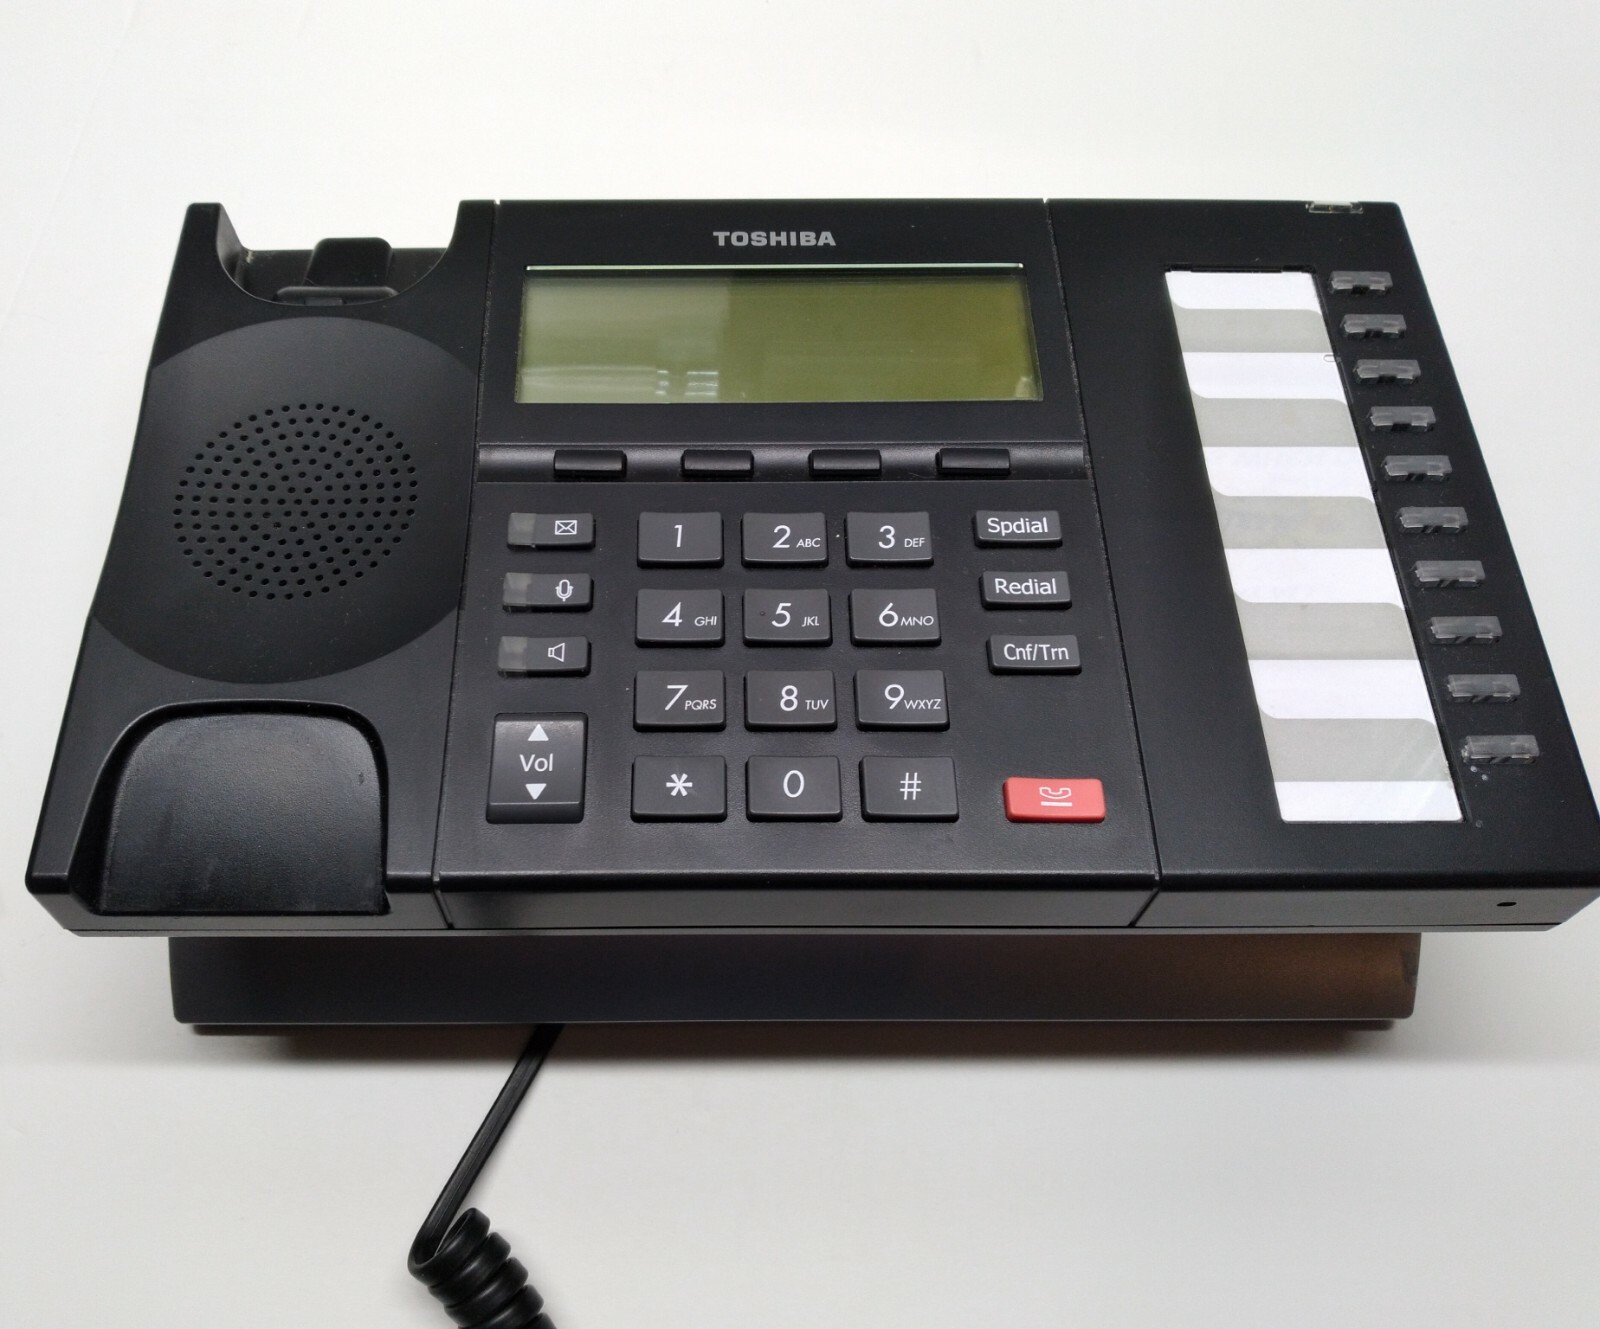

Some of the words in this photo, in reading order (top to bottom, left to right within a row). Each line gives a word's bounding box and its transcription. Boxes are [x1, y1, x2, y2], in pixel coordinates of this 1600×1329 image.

[712, 231, 836, 247] TOSHIBA
[673, 524, 683, 548] 1
[771, 524, 792, 549] 2
[795, 537, 822, 549] ABC
[877, 524, 896, 550] 3
[903, 536, 926, 548] DEF
[986, 516, 1049, 537] Spdial
[994, 577, 1058, 596] Redial
[660, 601, 684, 628] 4
[693, 615, 718, 627] GHI
[771, 602, 792, 628] 5
[801, 615, 820, 628] JKL
[878, 601, 900, 628] 6
[899, 615, 935, 627] MNO
[1003, 642, 1071, 662] Cnf/Trn
[664, 684, 689, 711] 7
[684, 698, 717, 711] PQRS
[779, 684, 799, 712] 8
[804, 698, 830, 711] TUV
[883, 682, 905, 711] 9
[903, 697, 943, 711] WXYZ
[517, 752, 555, 773] Vol
[782, 769, 806, 799] 0
[898, 771, 923, 801] #
